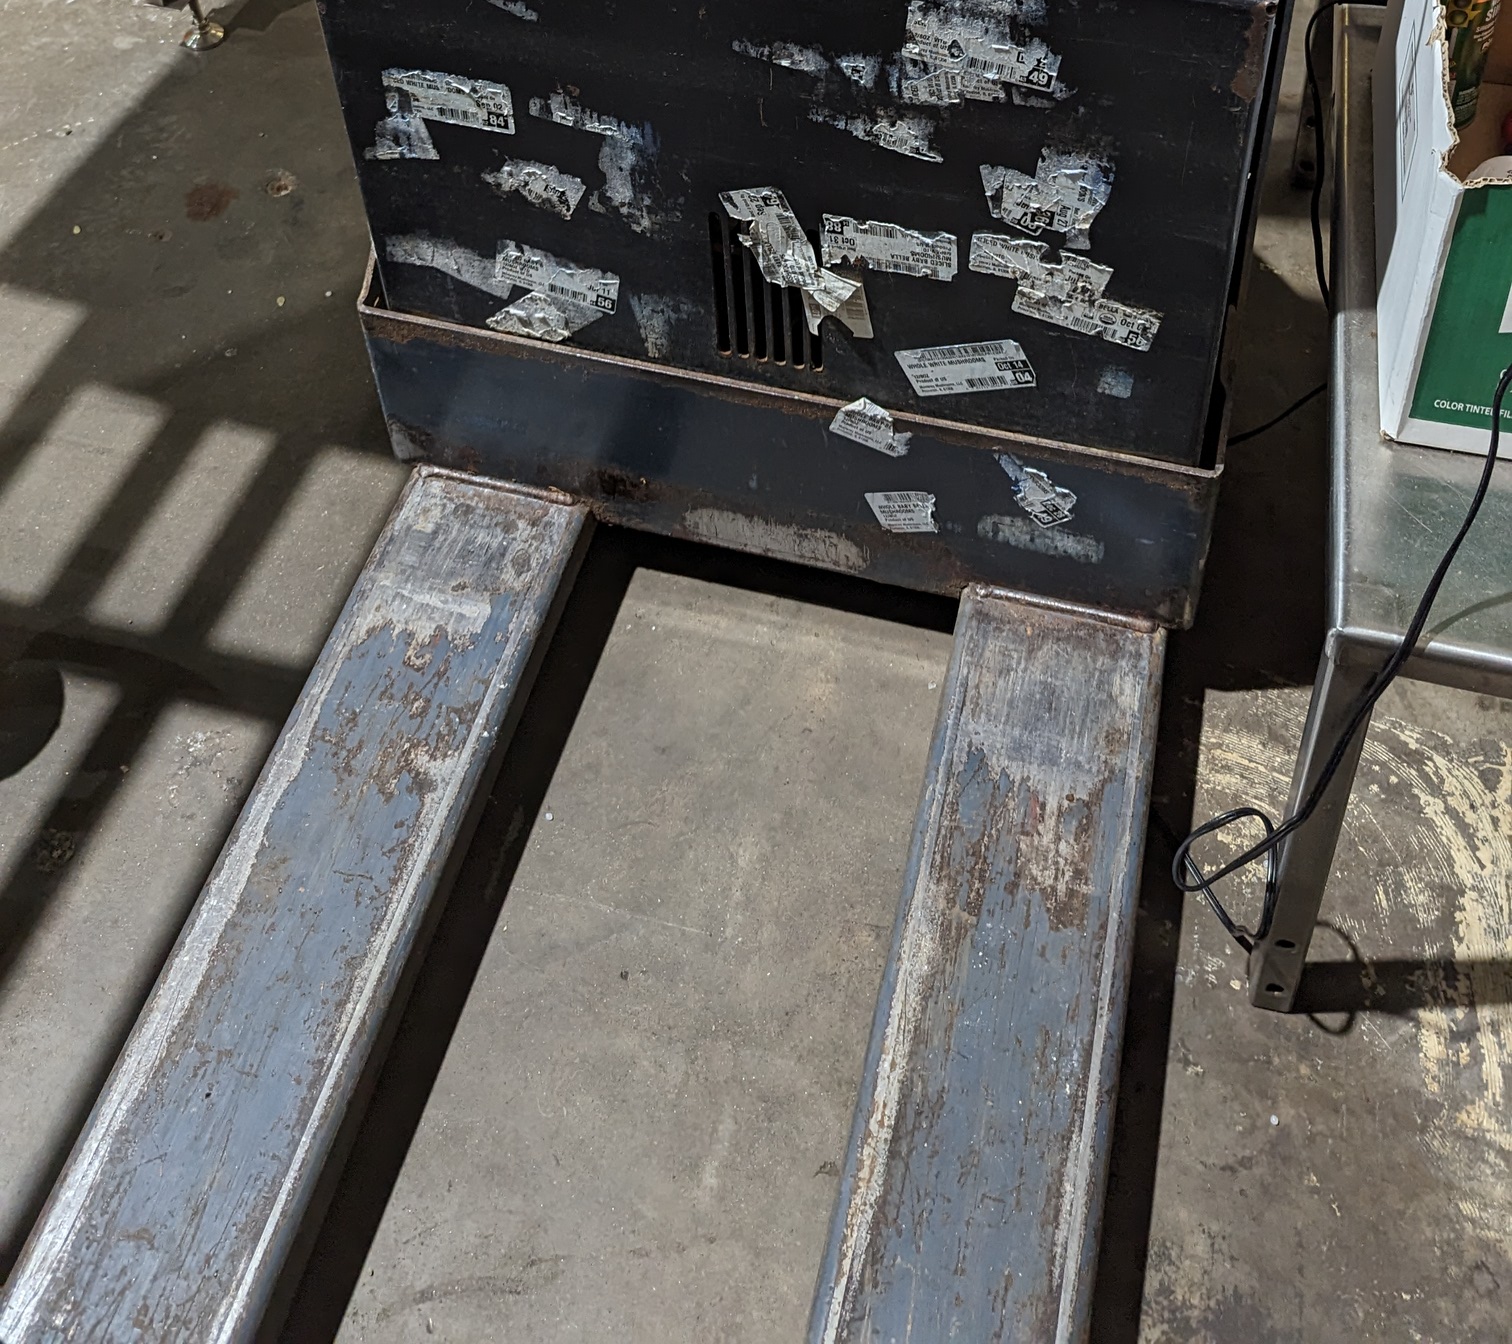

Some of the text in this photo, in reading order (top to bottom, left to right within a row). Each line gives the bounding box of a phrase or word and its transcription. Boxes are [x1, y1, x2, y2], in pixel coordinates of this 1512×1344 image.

[1029, 71, 1048, 85] 49
[406, 80, 424, 88] WHITE
[489, 115, 505, 127] 84
[826, 221, 842, 232] 88
[829, 236, 855, 246] Oct 31
[890, 253, 952, 268] SLICED BABY BELLA
[597, 297, 612, 309] 56
[1120, 318, 1135, 329] Oct
[907, 357, 986, 369] WHOLE WHITE MUSHROOMS
[997, 362, 1011, 370] Oct
[1016, 372, 1032, 383] 04
[1434, 399, 1464, 411] COLOR
[1465, 403, 1493, 416] TINTE
